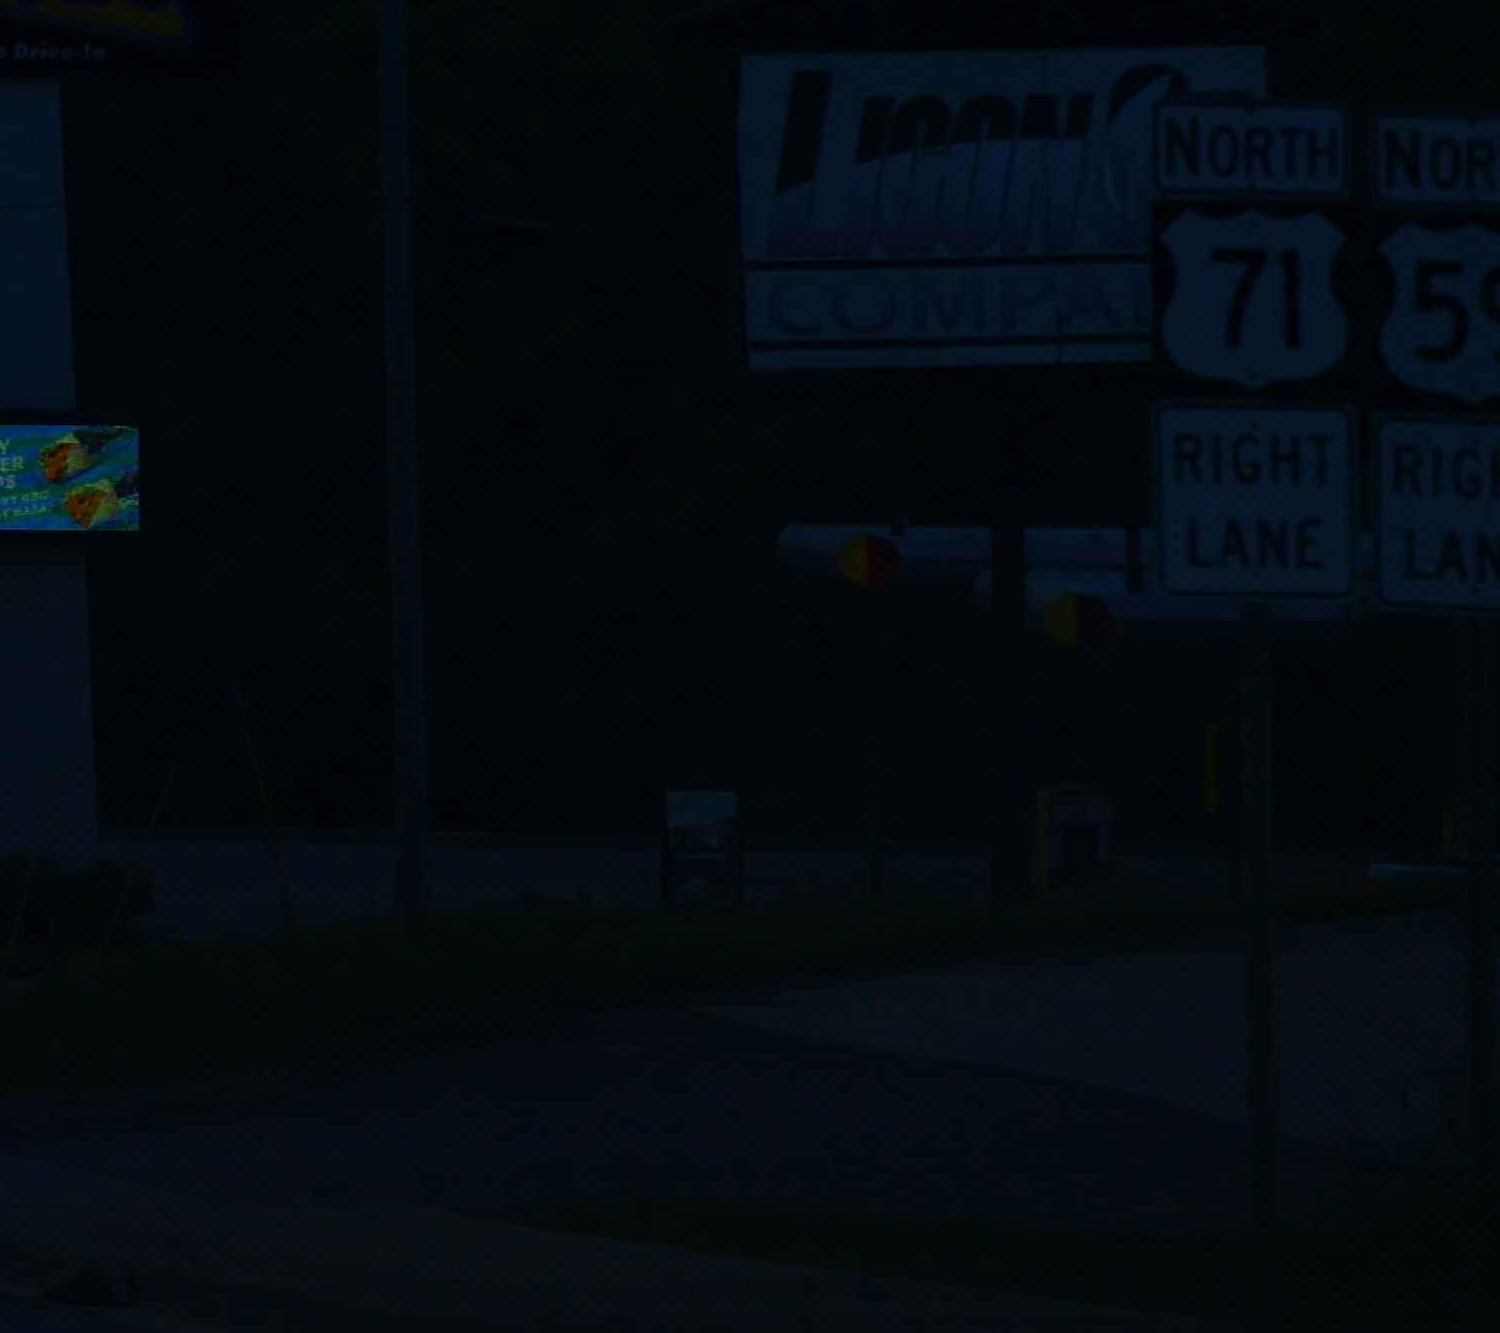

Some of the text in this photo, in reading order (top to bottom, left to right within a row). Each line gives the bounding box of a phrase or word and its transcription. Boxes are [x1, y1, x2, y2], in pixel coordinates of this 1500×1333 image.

[1165, 116, 1339, 179] NORTH
[1386, 129, 1500, 191] NOR
[767, 265, 1151, 337] COMPA
[1211, 248, 1300, 349] 71
[1174, 434, 1332, 486] RIGHT
[1392, 445, 1500, 500] RIG
[1187, 518, 1325, 568] LANE
[1405, 530, 1500, 581] LAN
